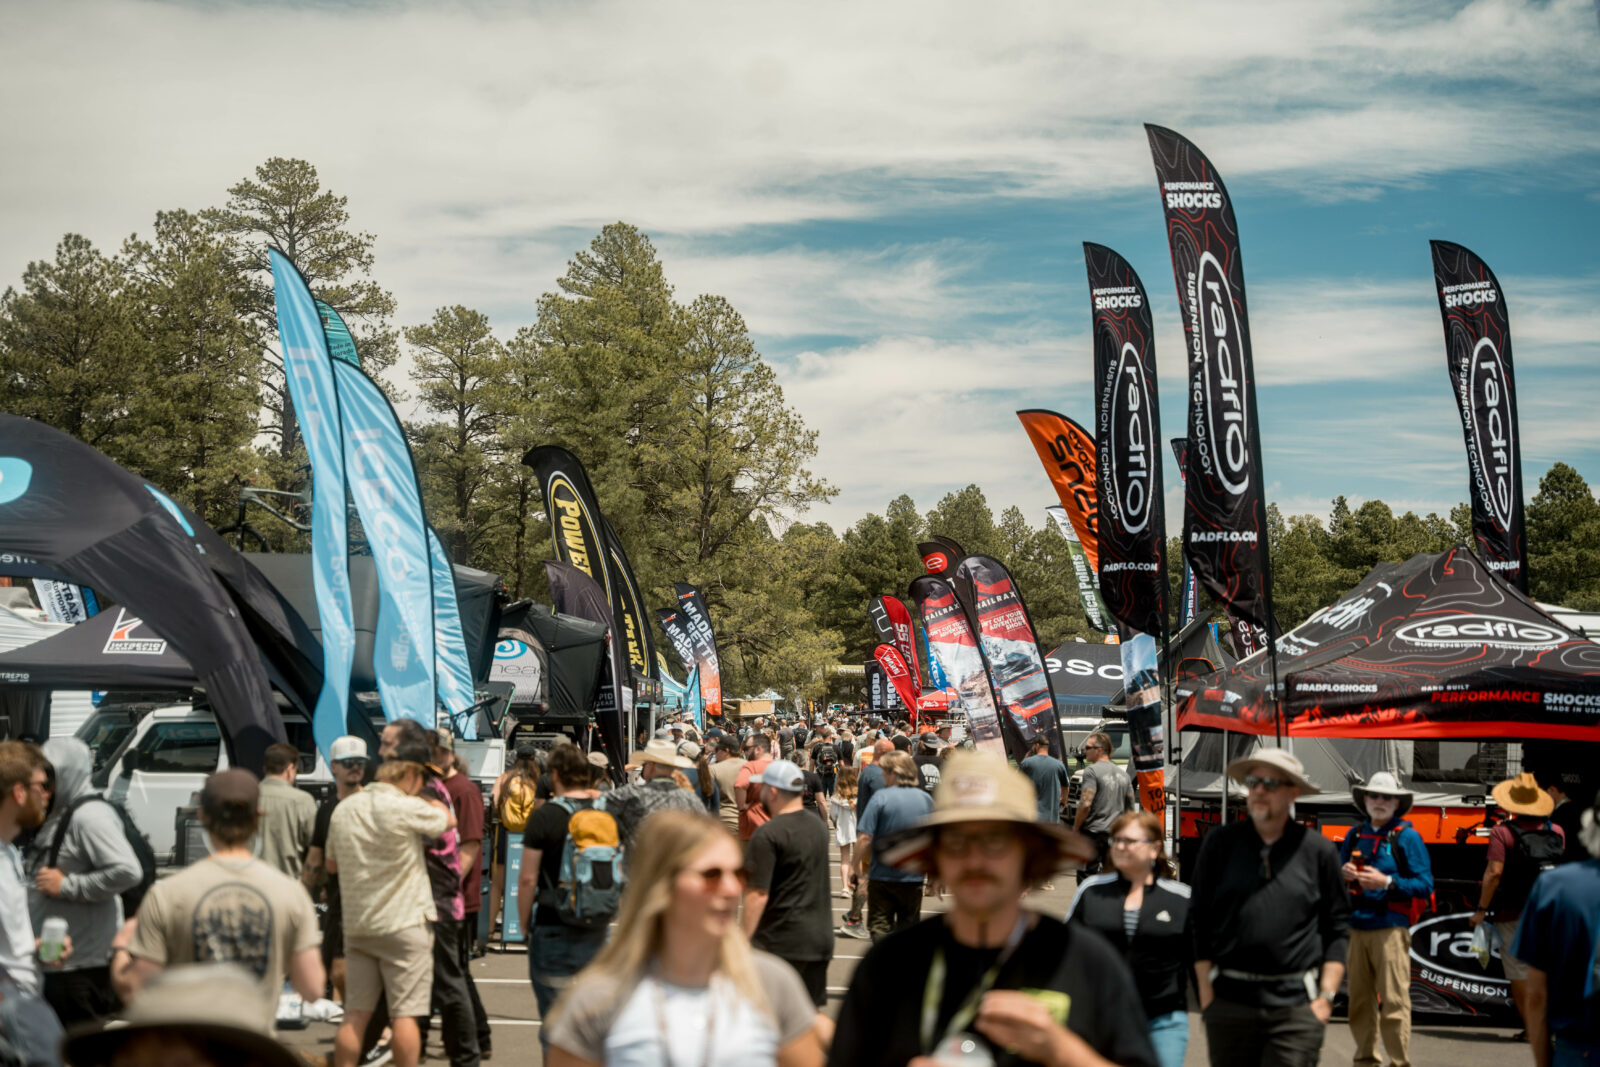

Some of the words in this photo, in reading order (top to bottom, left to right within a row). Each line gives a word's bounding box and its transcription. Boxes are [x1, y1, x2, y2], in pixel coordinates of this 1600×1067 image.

[1164, 182, 1214, 190] PERFORMANCE
[1166, 193, 1221, 208] SHOCKS
[1093, 286, 1135, 295] PERFORMANCE
[1443, 281, 1490, 293] PERFORMANCE
[1445, 290, 1496, 307] SHOCKS
[1095, 295, 1141, 309] SHOCKS
[1187, 271, 1203, 363] SUSPENSION
[1205, 280, 1247, 472] radflo
[1101, 359, 1118, 432] SUSPENSION
[1193, 372, 1213, 476] TECHNOLOGY
[1459, 357, 1472, 429] SUSPENSION
[1467, 436, 1495, 518] TECHNOLOGY
[1481, 359, 1509, 515] radflo
[1125, 366, 1148, 517] radflo
[1101, 440, 1119, 520] TECHNOLOGY
[350, 428, 408, 582] ICECO
[977, 591, 1017, 609] RAILRAX
[682, 601, 713, 642] MADE
[1416, 621, 1553, 640] radflo
[667, 623, 693, 653] MAD
[686, 621, 719, 675] BETTER
[883, 655, 901, 675] WARN
[1296, 683, 1378, 693] #RADFLOSHOCKS
[1432, 690, 1541, 703] PERFORMANCE
[1543, 692, 1600, 706] SHOCKS
[1420, 969, 1508, 997] SUSPENSION
